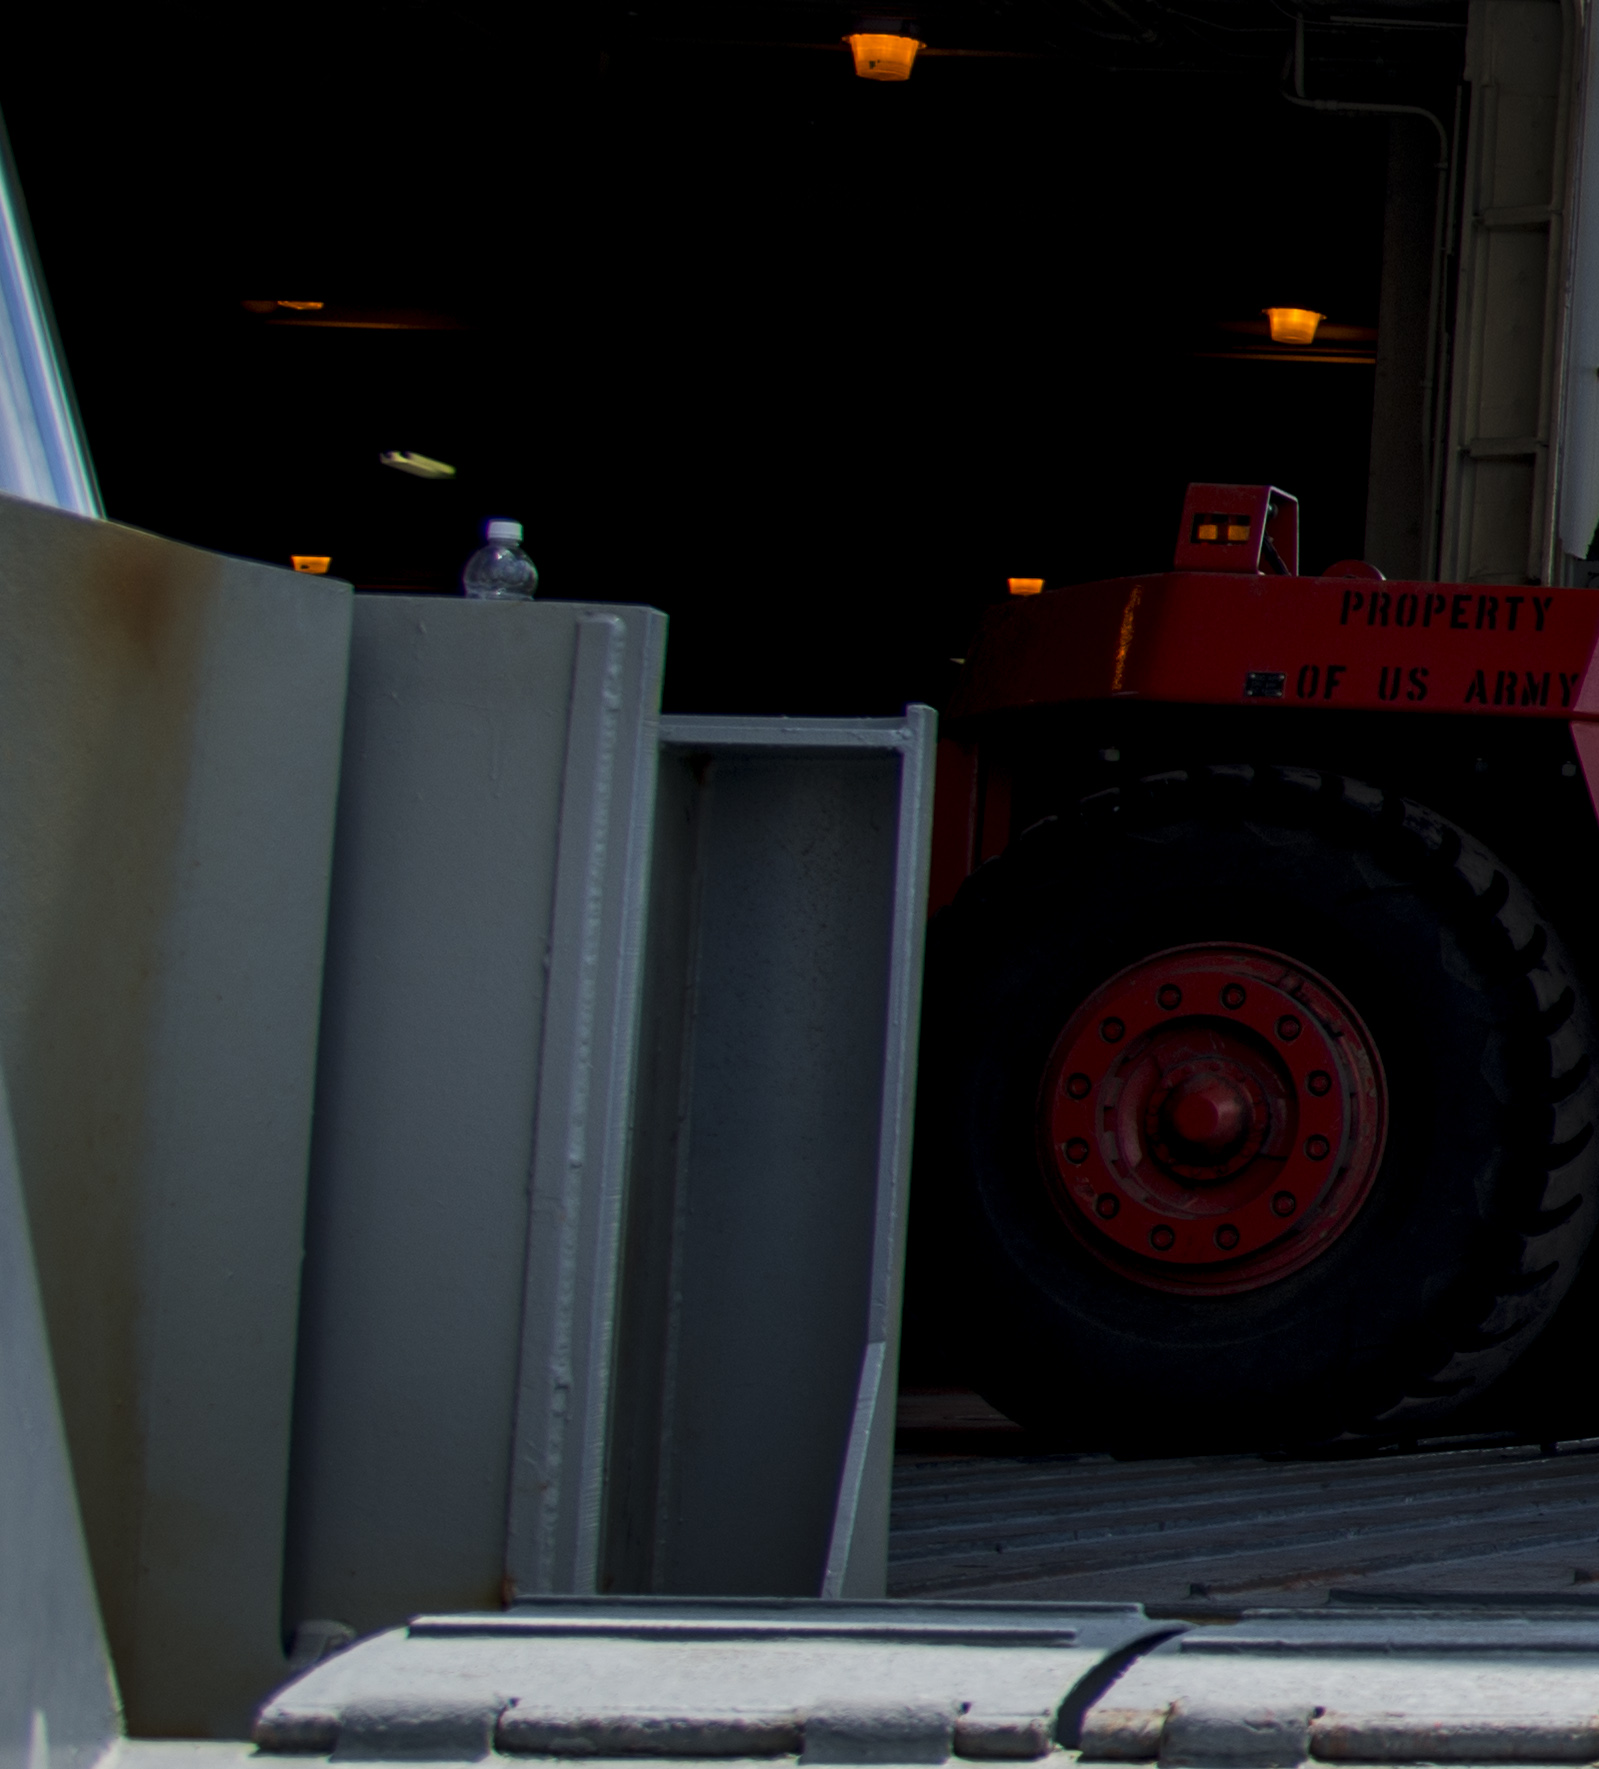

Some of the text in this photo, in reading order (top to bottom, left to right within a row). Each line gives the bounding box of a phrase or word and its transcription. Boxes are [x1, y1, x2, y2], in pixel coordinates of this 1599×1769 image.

[1340, 590, 1553, 631] PROPERTY
[1297, 665, 1346, 699] OF
[1379, 666, 1429, 700] US
[1465, 670, 1578, 707] ARMY
